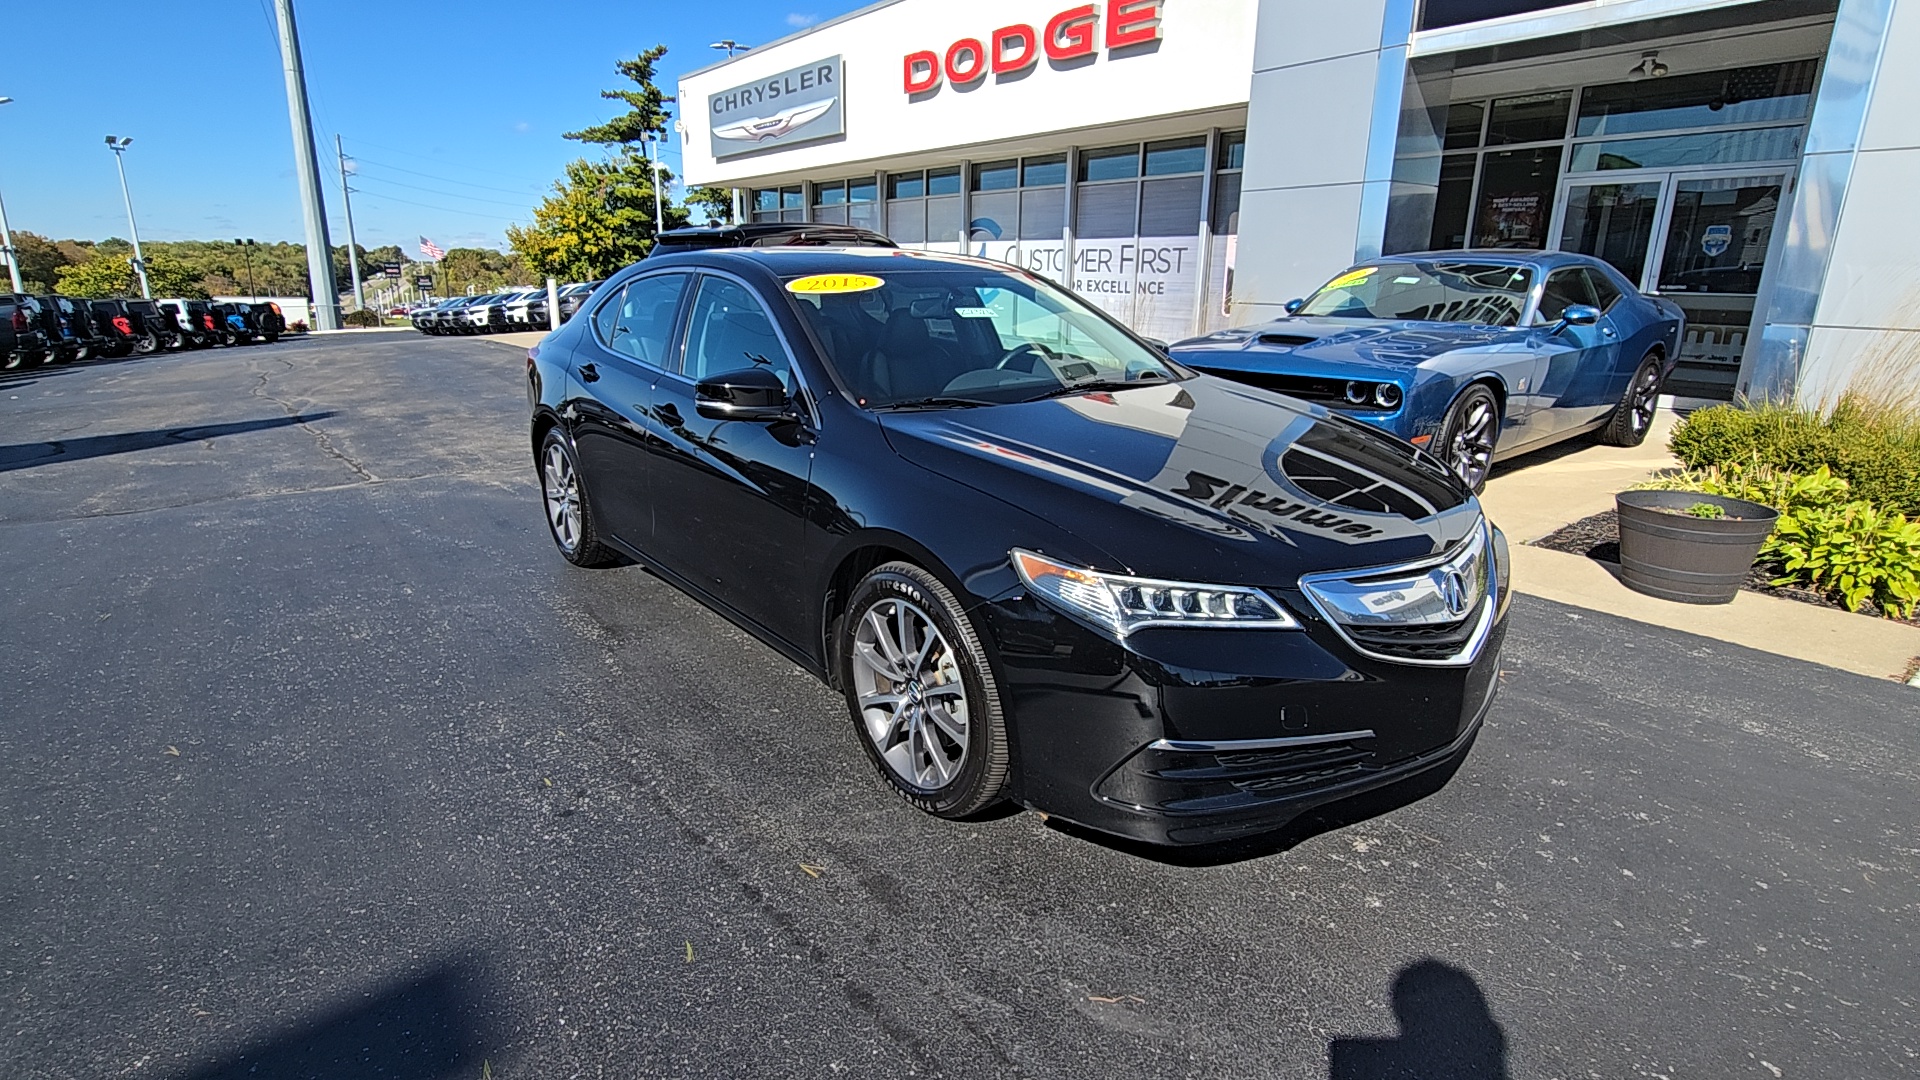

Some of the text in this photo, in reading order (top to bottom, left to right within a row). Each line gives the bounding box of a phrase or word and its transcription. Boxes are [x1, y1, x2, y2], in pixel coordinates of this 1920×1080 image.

[904, 0, 1162, 94] DODGE
[712, 64, 833, 115] CHRYSLER
[807, 277, 868, 291] 2015
[1086, 279, 1165, 296] EXCELLNCE
